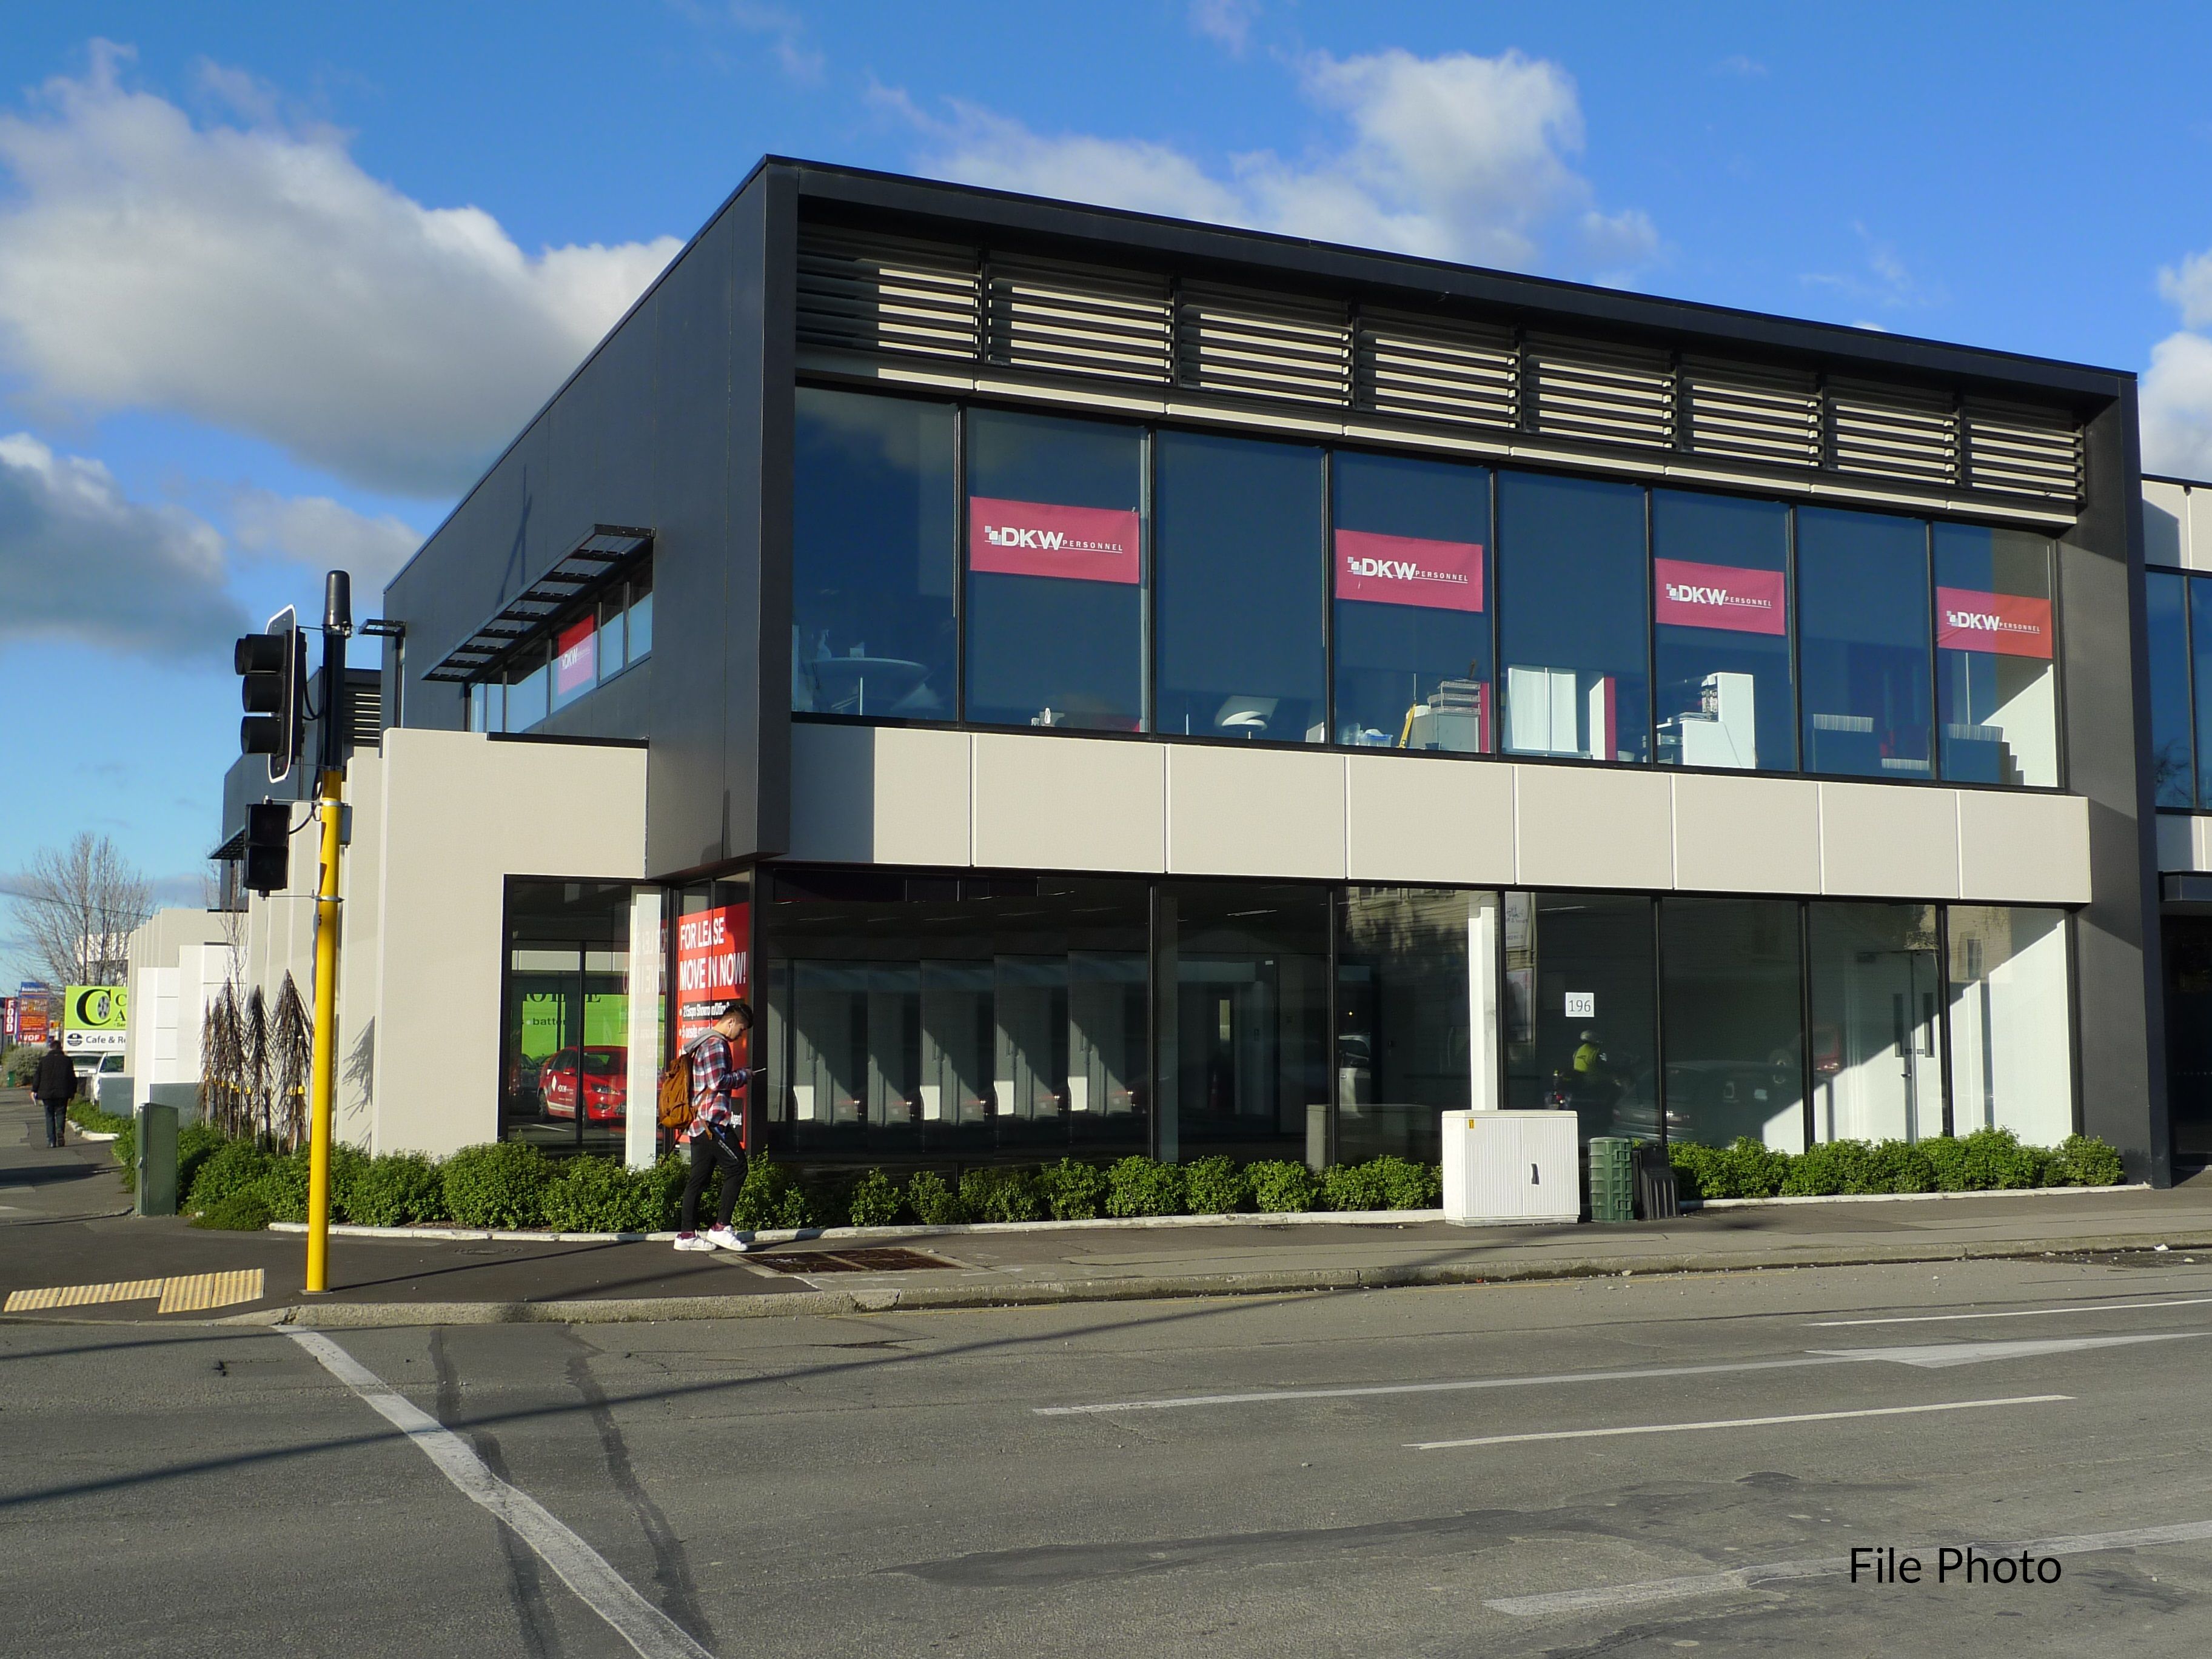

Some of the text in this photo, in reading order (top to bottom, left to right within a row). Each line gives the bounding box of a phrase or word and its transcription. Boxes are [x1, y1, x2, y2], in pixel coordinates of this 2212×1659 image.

[1001, 526, 1123, 552] DKW PERSONNEL
[1362, 557, 1469, 582] DKW PERSONNEL
[1678, 584, 1772, 607] DKW PERSONNEL
[1957, 611, 2040, 632] DKW PERSONNEL
[680, 916, 725, 951] FOR LEASE
[679, 957, 706, 991] MOVE
[708, 955, 717, 988] IN
[719, 951, 746, 987] NOW!
[5, 999, 15, 1033] FOOD
[1569, 999, 1590, 1012] 196
